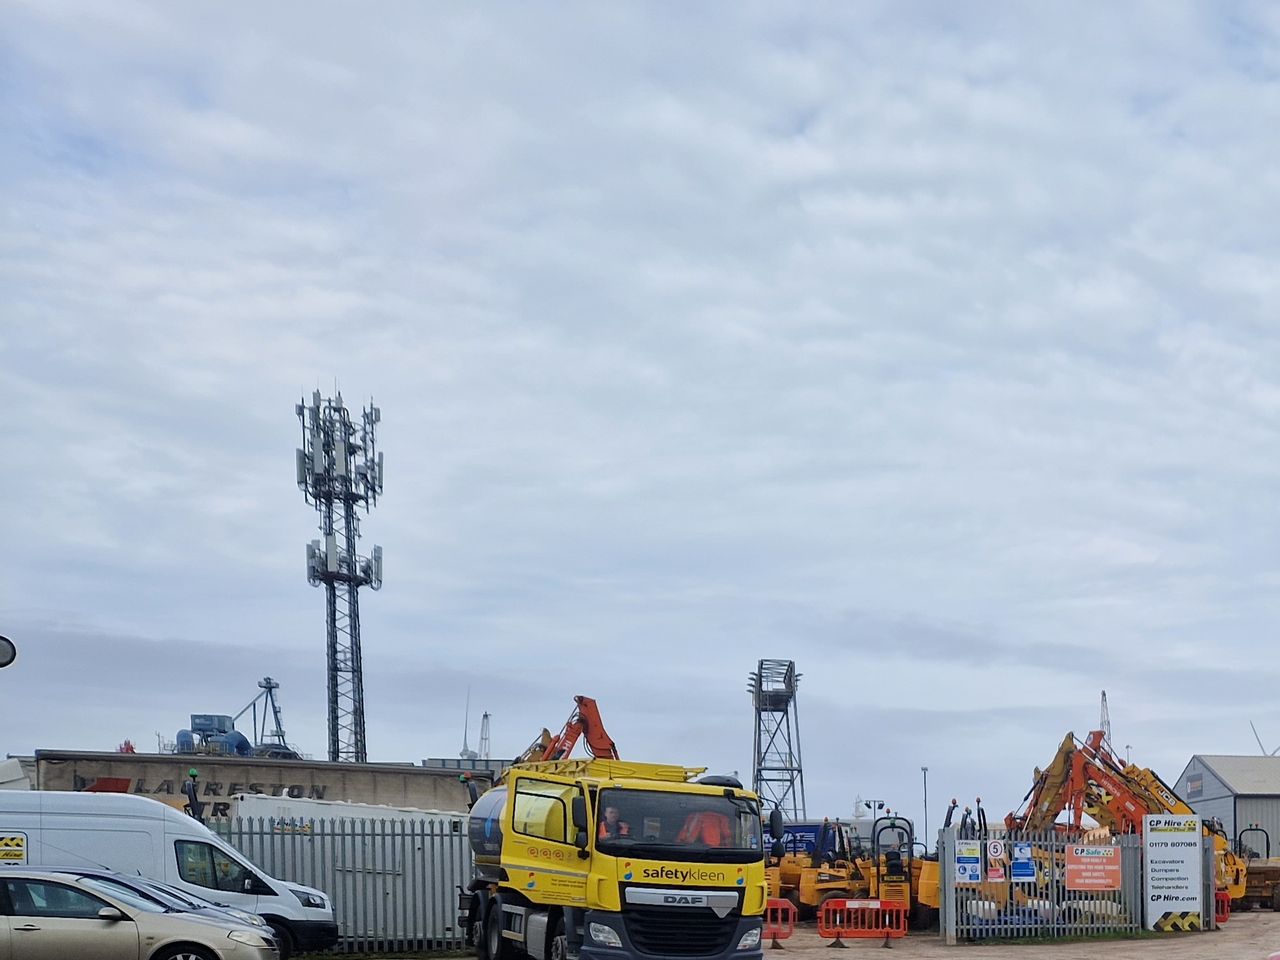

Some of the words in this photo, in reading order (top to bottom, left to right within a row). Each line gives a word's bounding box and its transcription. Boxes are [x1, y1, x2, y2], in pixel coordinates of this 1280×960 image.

[1158, 787, 1177, 807] JCB
[992, 844, 999, 854] 5
[1085, 848, 1102, 856] Safe
[643, 866, 725, 883] safetykleen
[663, 896, 703, 905] DAF
[1150, 894, 1162, 902] CP
[1163, 894, 1198, 902] Hire.com
